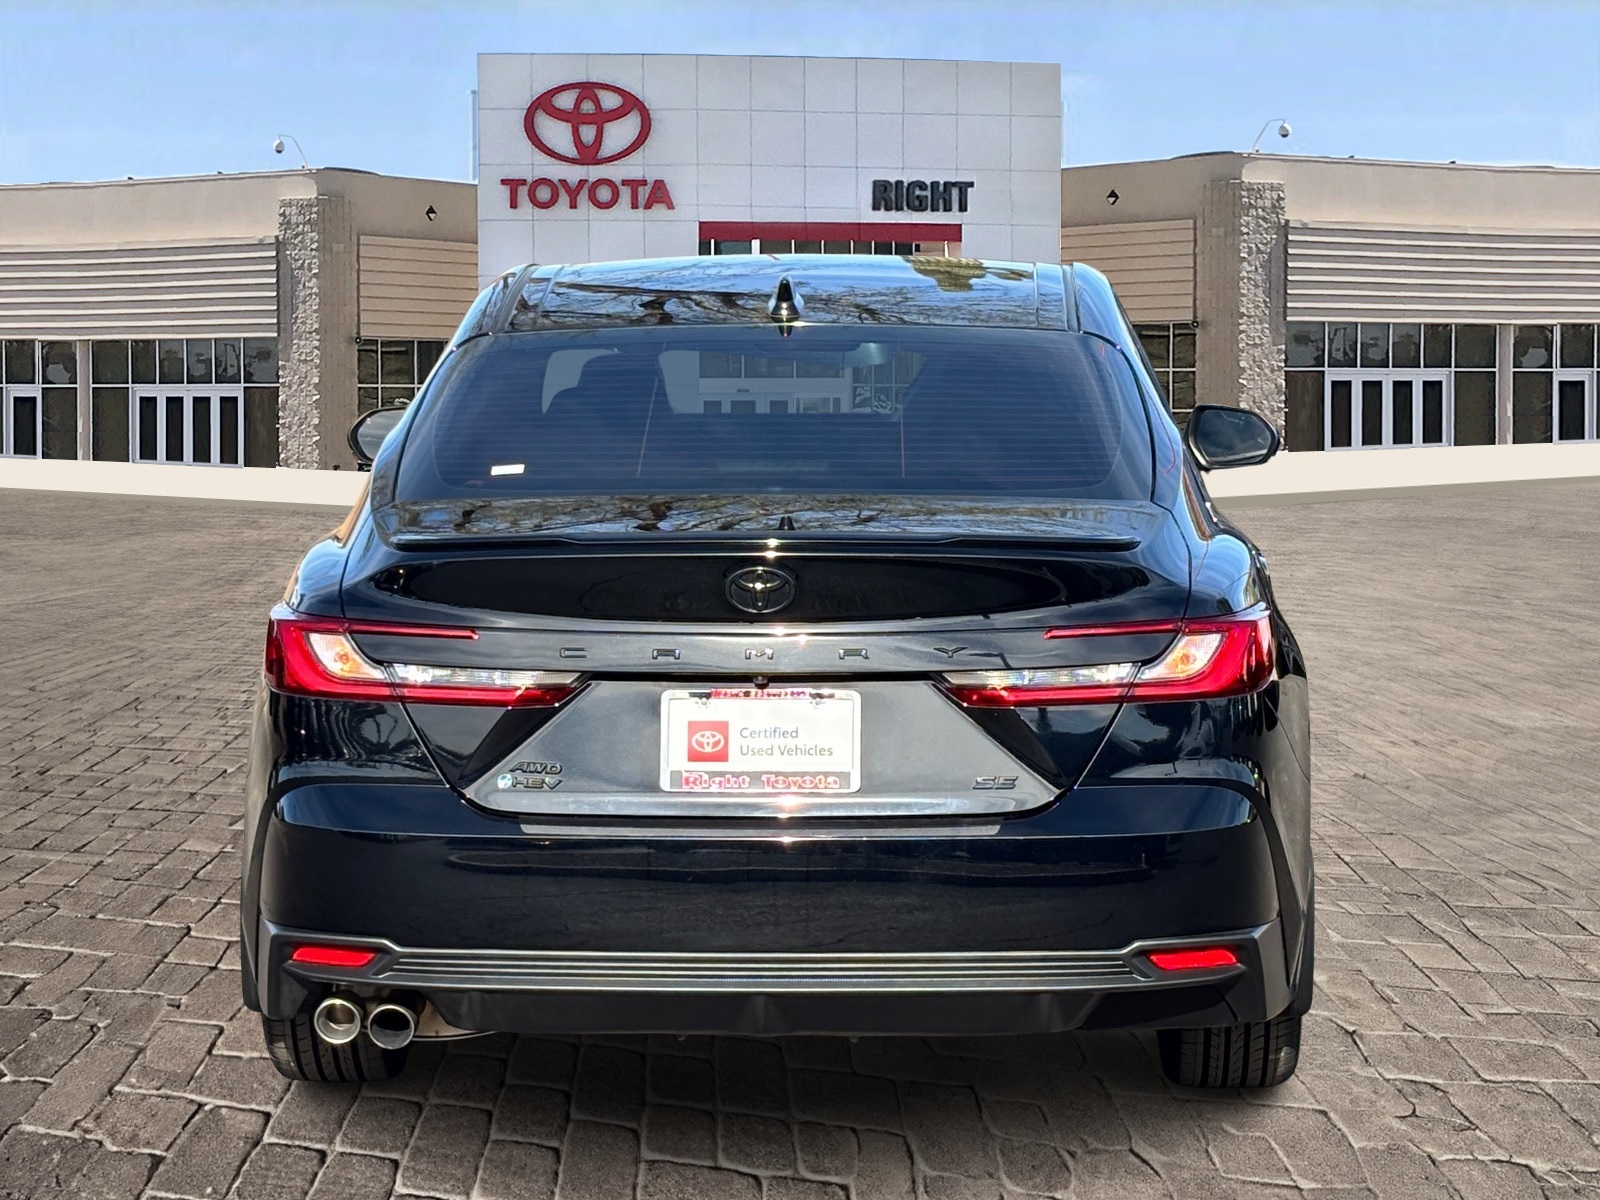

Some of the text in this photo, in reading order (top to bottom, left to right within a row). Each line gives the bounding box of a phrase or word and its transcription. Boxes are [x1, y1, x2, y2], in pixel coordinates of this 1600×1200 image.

[500, 177, 675, 210] TOYOTA
[871, 179, 975, 212] RIGHT
[559, 646, 969, 661] CAMRY
[739, 726, 799, 739] Certified
[739, 743, 833, 756] Used Vehicles
[508, 761, 563, 775] AWD
[511, 776, 563, 790] HEV
[682, 771, 840, 789] Right Toyota
[972, 775, 1019, 790] SE
